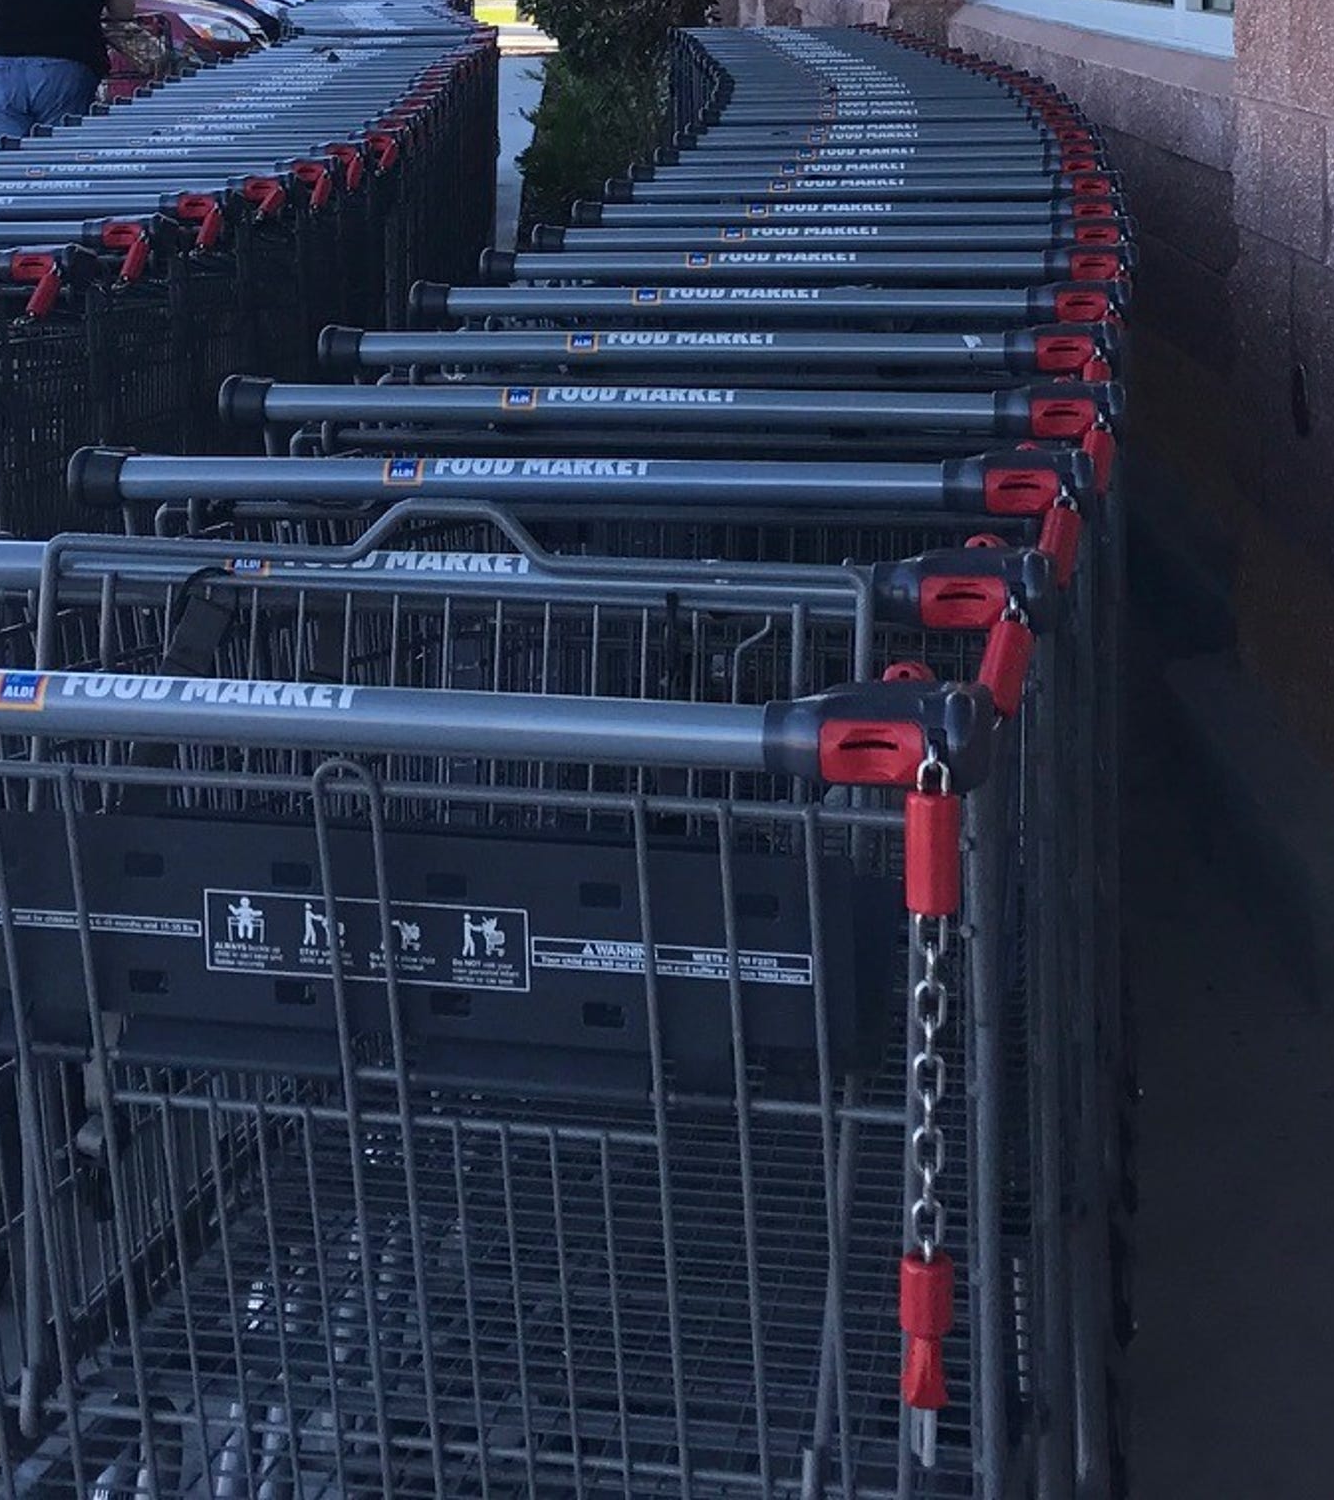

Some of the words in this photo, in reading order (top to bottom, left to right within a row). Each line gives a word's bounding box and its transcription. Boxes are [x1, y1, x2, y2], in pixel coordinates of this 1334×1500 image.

[434, 458, 516, 475] FOOD
[522, 460, 650, 476] MARKET
[385, 551, 530, 574] MARKET
[61, 675, 176, 700] FOOD
[181, 679, 364, 709] MARKET
[595, 944, 646, 959] WARNIN
